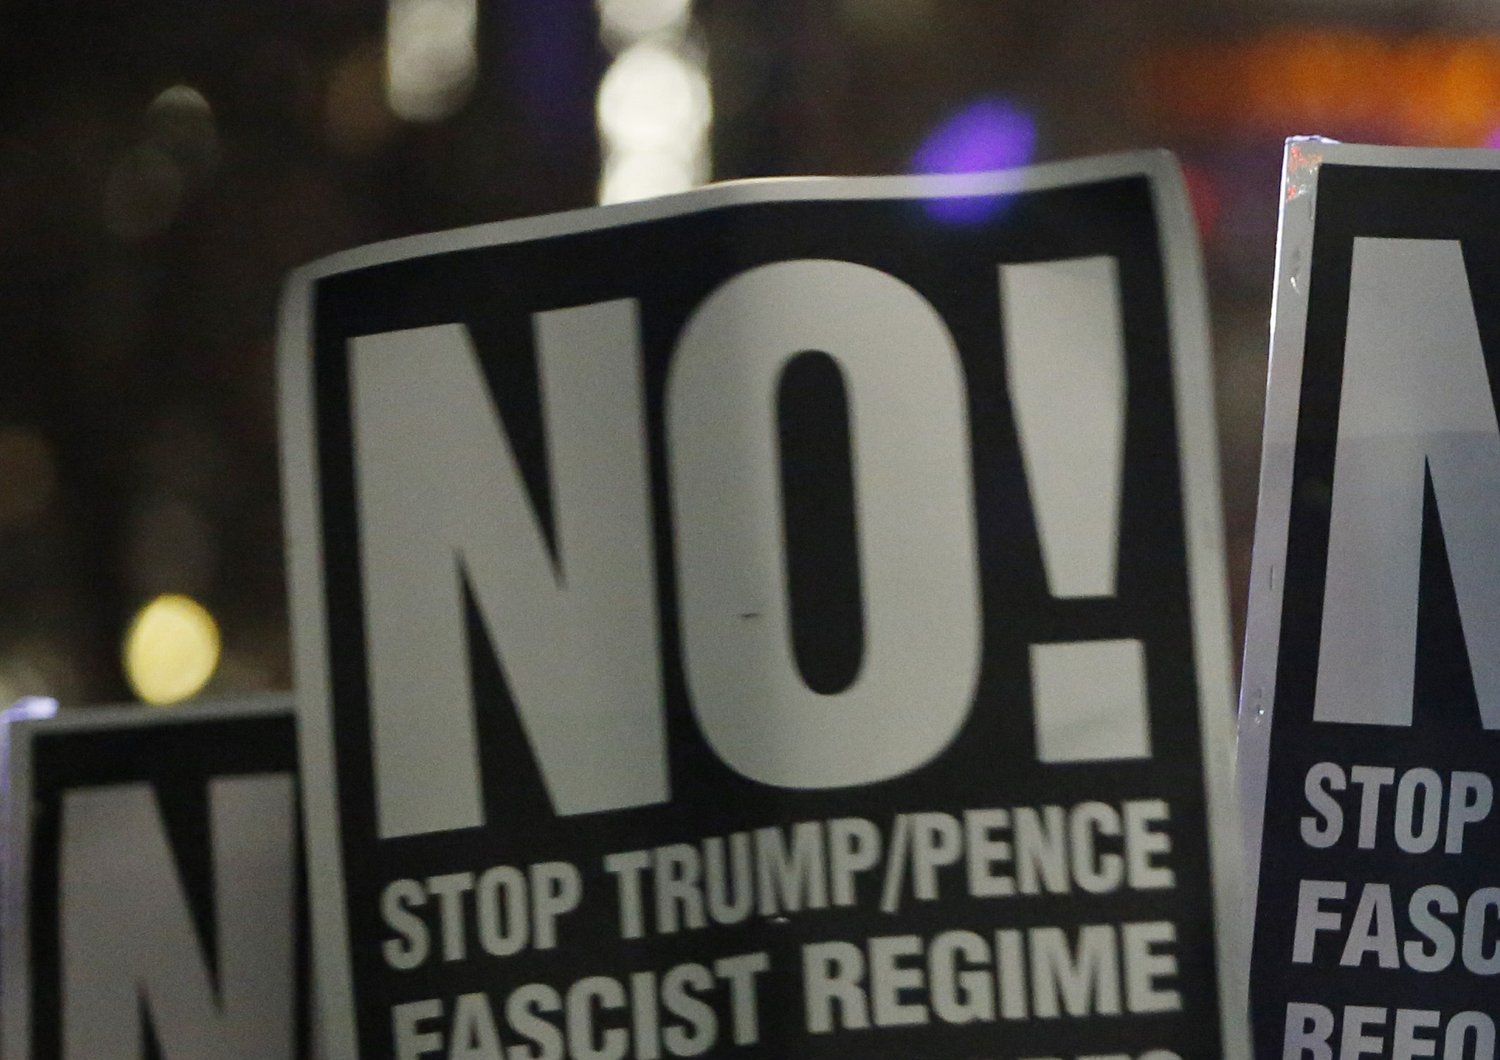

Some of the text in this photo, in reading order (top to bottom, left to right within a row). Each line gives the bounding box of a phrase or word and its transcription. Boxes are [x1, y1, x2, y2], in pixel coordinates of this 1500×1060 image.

[347, 254, 1152, 839] NO!
[1299, 761, 1492, 854] STOP
[380, 800, 1174, 970] STOP TRUMP/PENCE
[802, 920, 1183, 1034] REGIME
